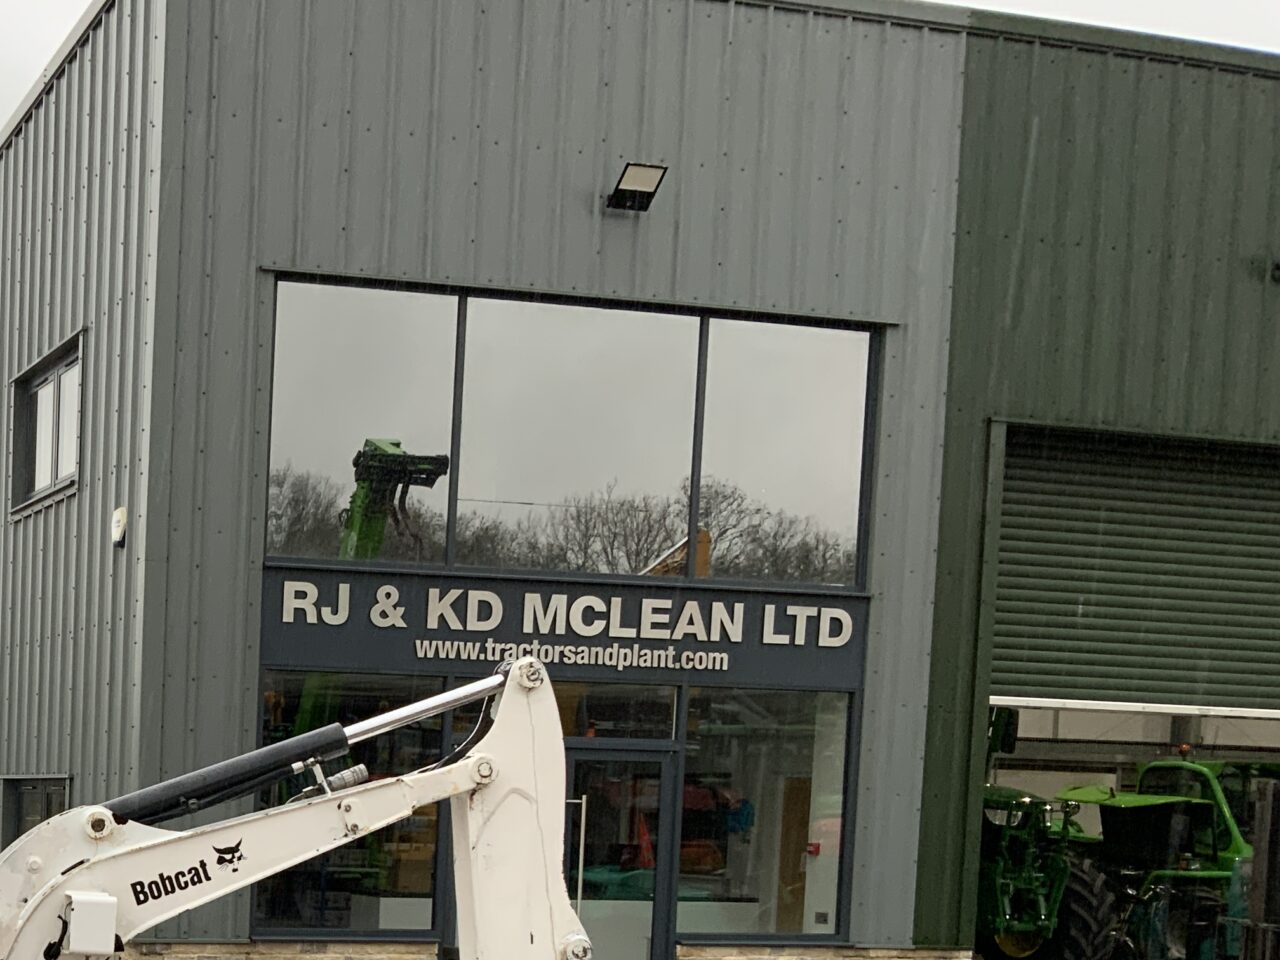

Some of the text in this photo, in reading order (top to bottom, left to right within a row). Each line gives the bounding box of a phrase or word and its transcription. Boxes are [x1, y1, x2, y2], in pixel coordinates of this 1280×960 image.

[282, 580, 853, 648] RJ & KD MCLEAN LTD
[415, 637, 729, 671] www.tractorsandplant.com
[130, 859, 212, 906] Bobcat
